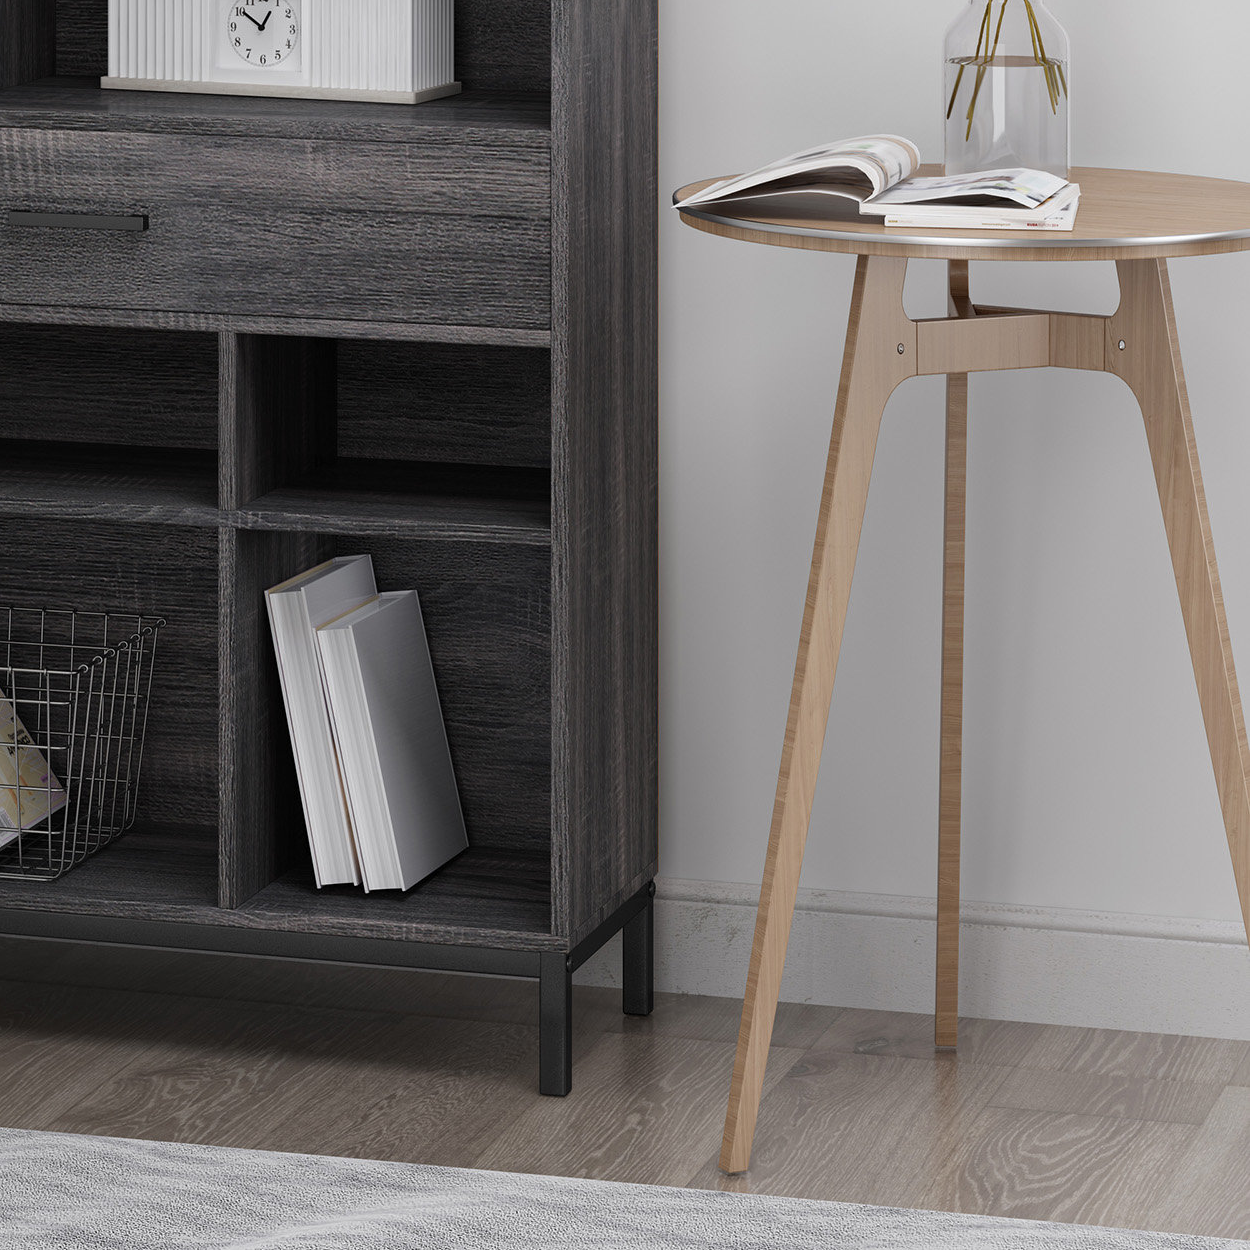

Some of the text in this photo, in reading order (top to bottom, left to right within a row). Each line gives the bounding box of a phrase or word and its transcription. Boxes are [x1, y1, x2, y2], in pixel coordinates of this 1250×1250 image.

[235, 7, 245, 16] 10
[285, 9, 292, 19] 2
[230, 22, 237, 32] 9
[289, 24, 296, 35] 3
[234, 37, 241, 47] 8
[285, 39, 292, 49] 4
[246, 49, 251, 59] 7
[259, 54, 266, 64] 6
[274, 50, 281, 60] 5
